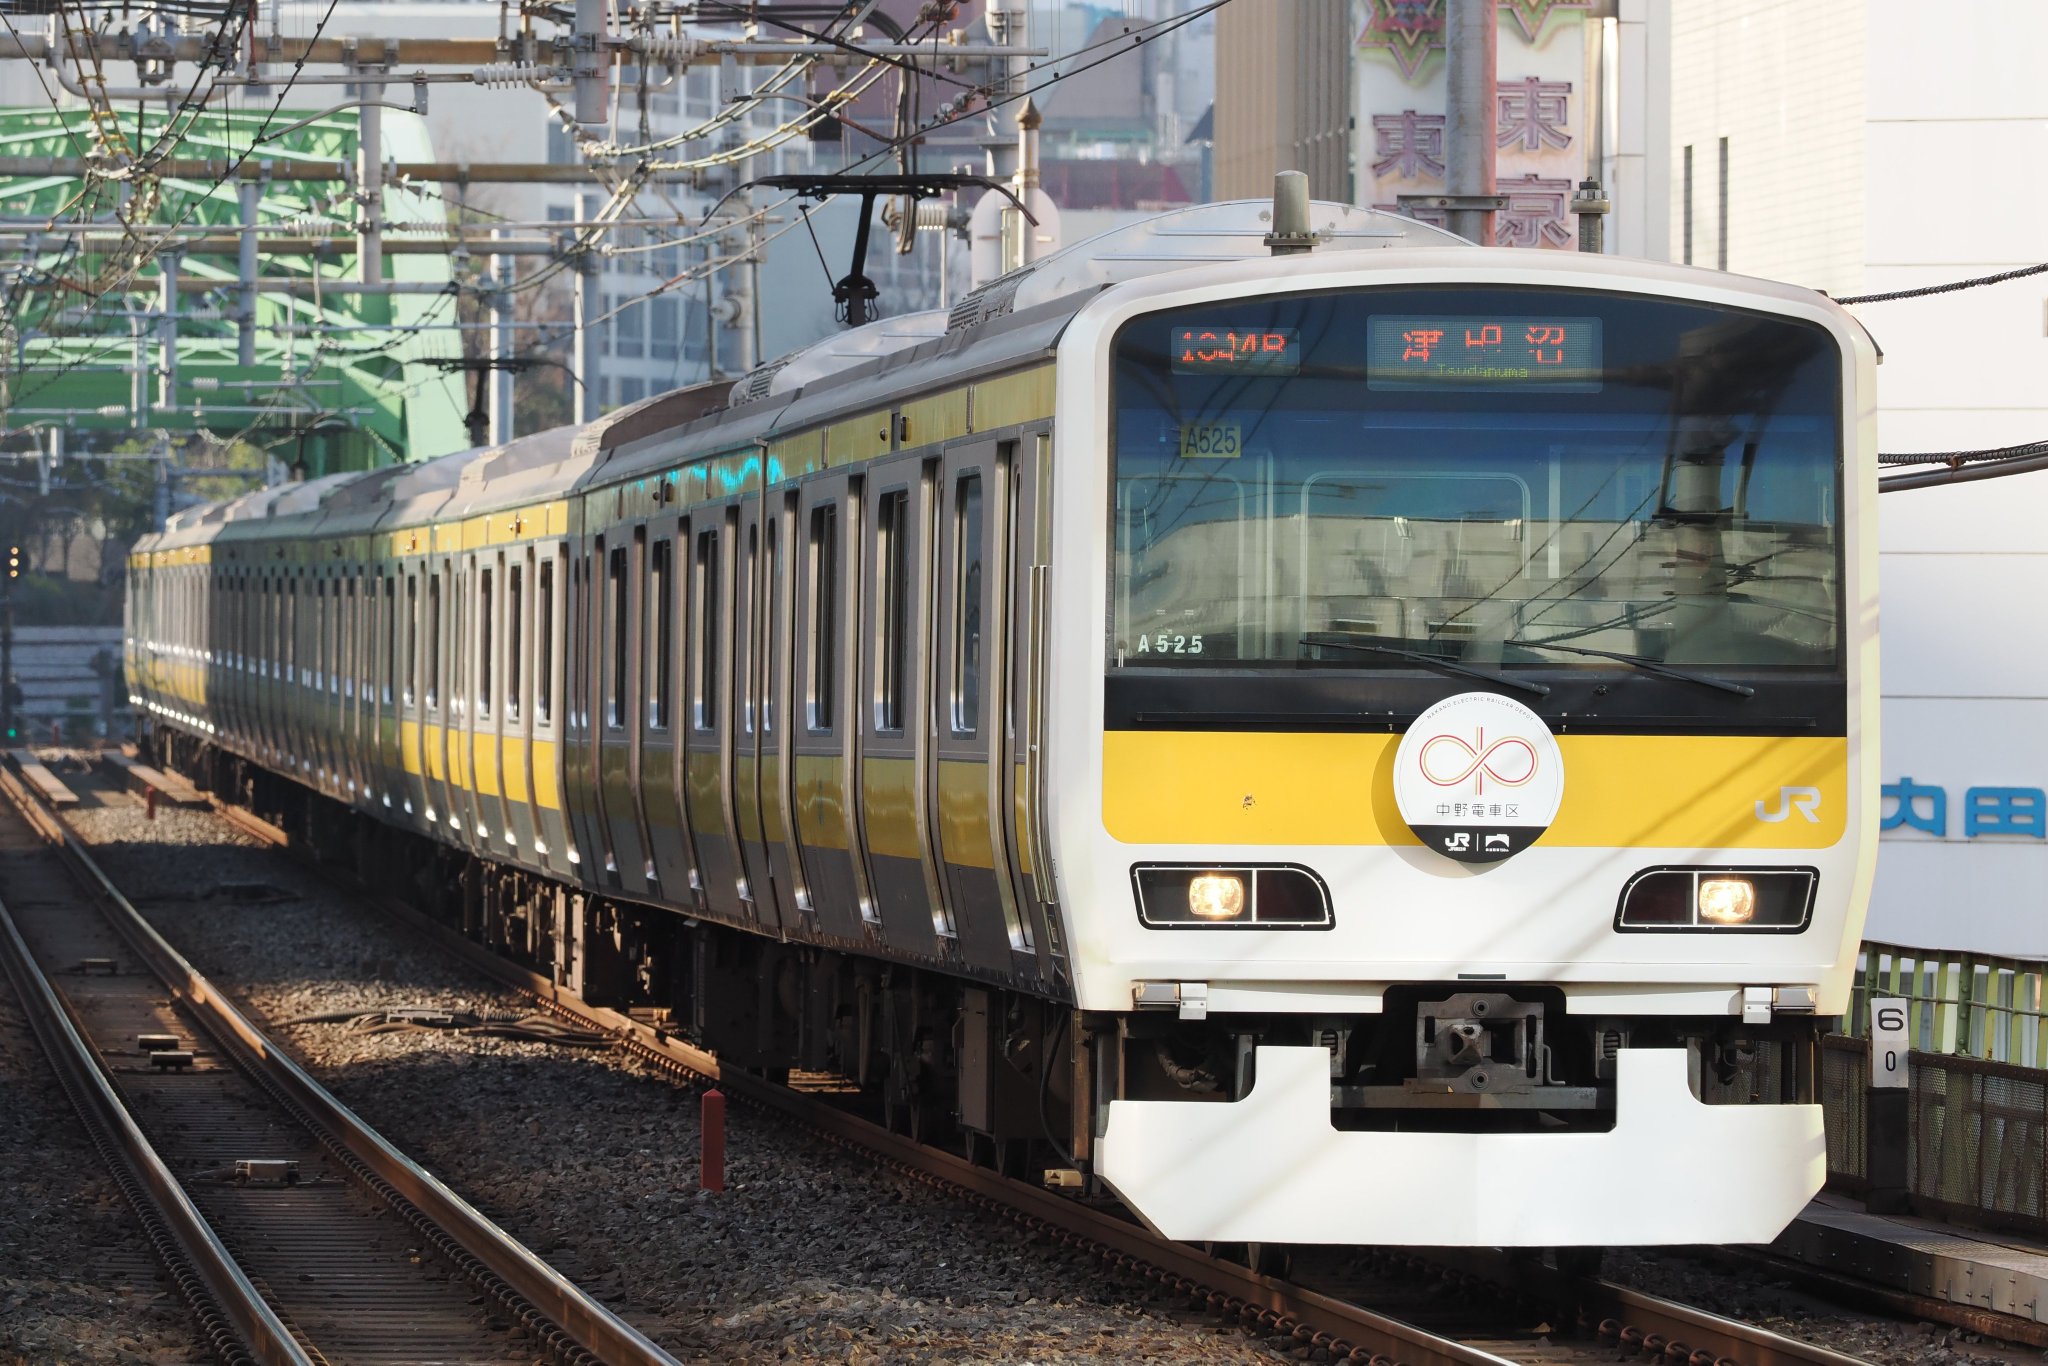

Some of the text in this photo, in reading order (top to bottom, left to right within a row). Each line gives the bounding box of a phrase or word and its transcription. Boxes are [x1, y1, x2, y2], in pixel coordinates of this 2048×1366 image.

[1496, 76, 1573, 247] 東京
[1437, 364, 1528, 378] Tsudanuma
[1185, 427, 1236, 454] A525
[1427, 696, 1534, 721] NAKANO ELECTRIC RAILCAR DEPOT
[1436, 803, 1519, 818] 中野電車区
[1755, 786, 1821, 823] JR
[1444, 832, 1471, 847] JR
[1878, 1008, 1904, 1031] 6
[1885, 1051, 1896, 1071] 0
